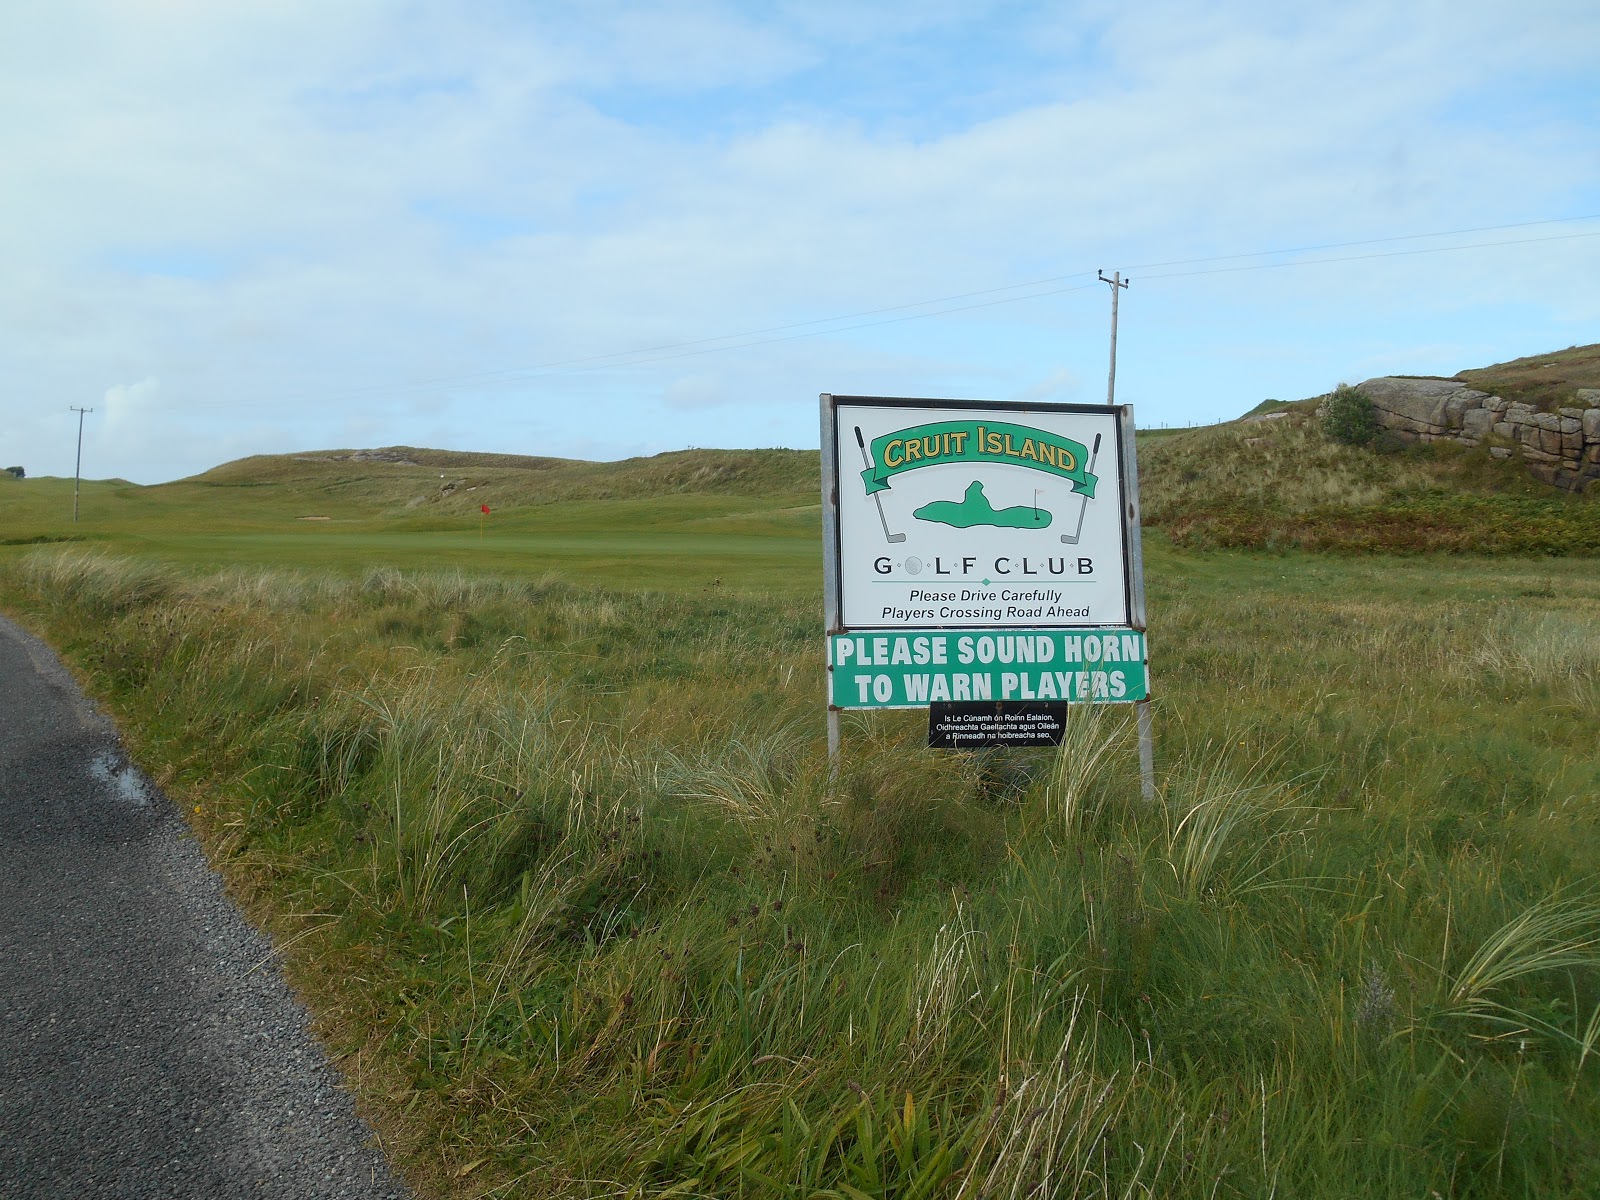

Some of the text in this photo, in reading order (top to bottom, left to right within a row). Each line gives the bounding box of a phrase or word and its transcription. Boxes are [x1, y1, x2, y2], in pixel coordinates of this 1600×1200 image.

[909, 590, 1062, 603] Please Drive Carefully
[882, 605, 1090, 620] Players Crossing Road Ahead
[836, 635, 1140, 666] PLEASE SOUND HORN
[855, 670, 1127, 703] TO WARN PLAYERS
